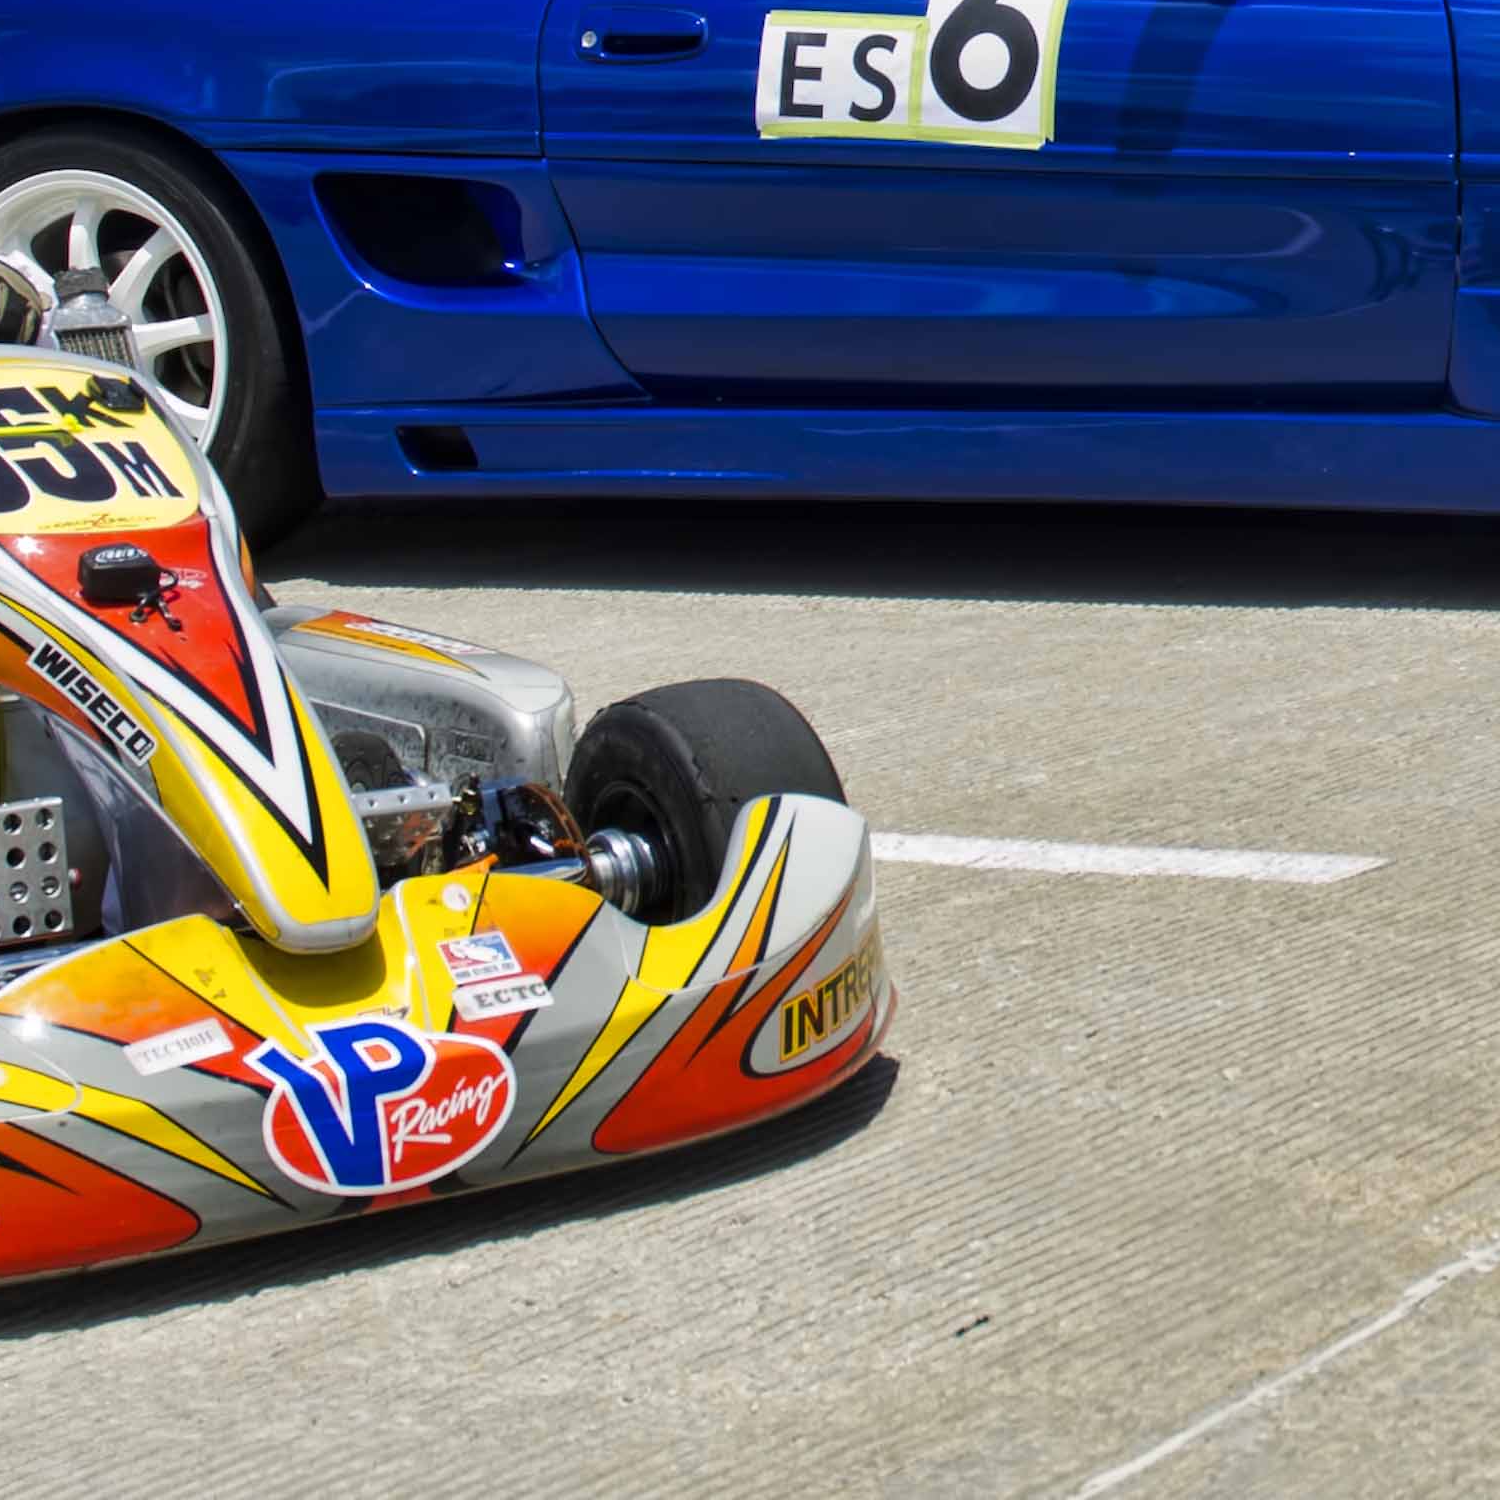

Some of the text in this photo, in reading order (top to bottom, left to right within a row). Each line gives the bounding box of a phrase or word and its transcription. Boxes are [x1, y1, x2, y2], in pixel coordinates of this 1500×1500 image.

[779, 31, 898, 122] ES
[33, 642, 156, 762] WISECO
[472, 981, 547, 1009] ECTC
[254, 1020, 507, 1188] VP Racing
